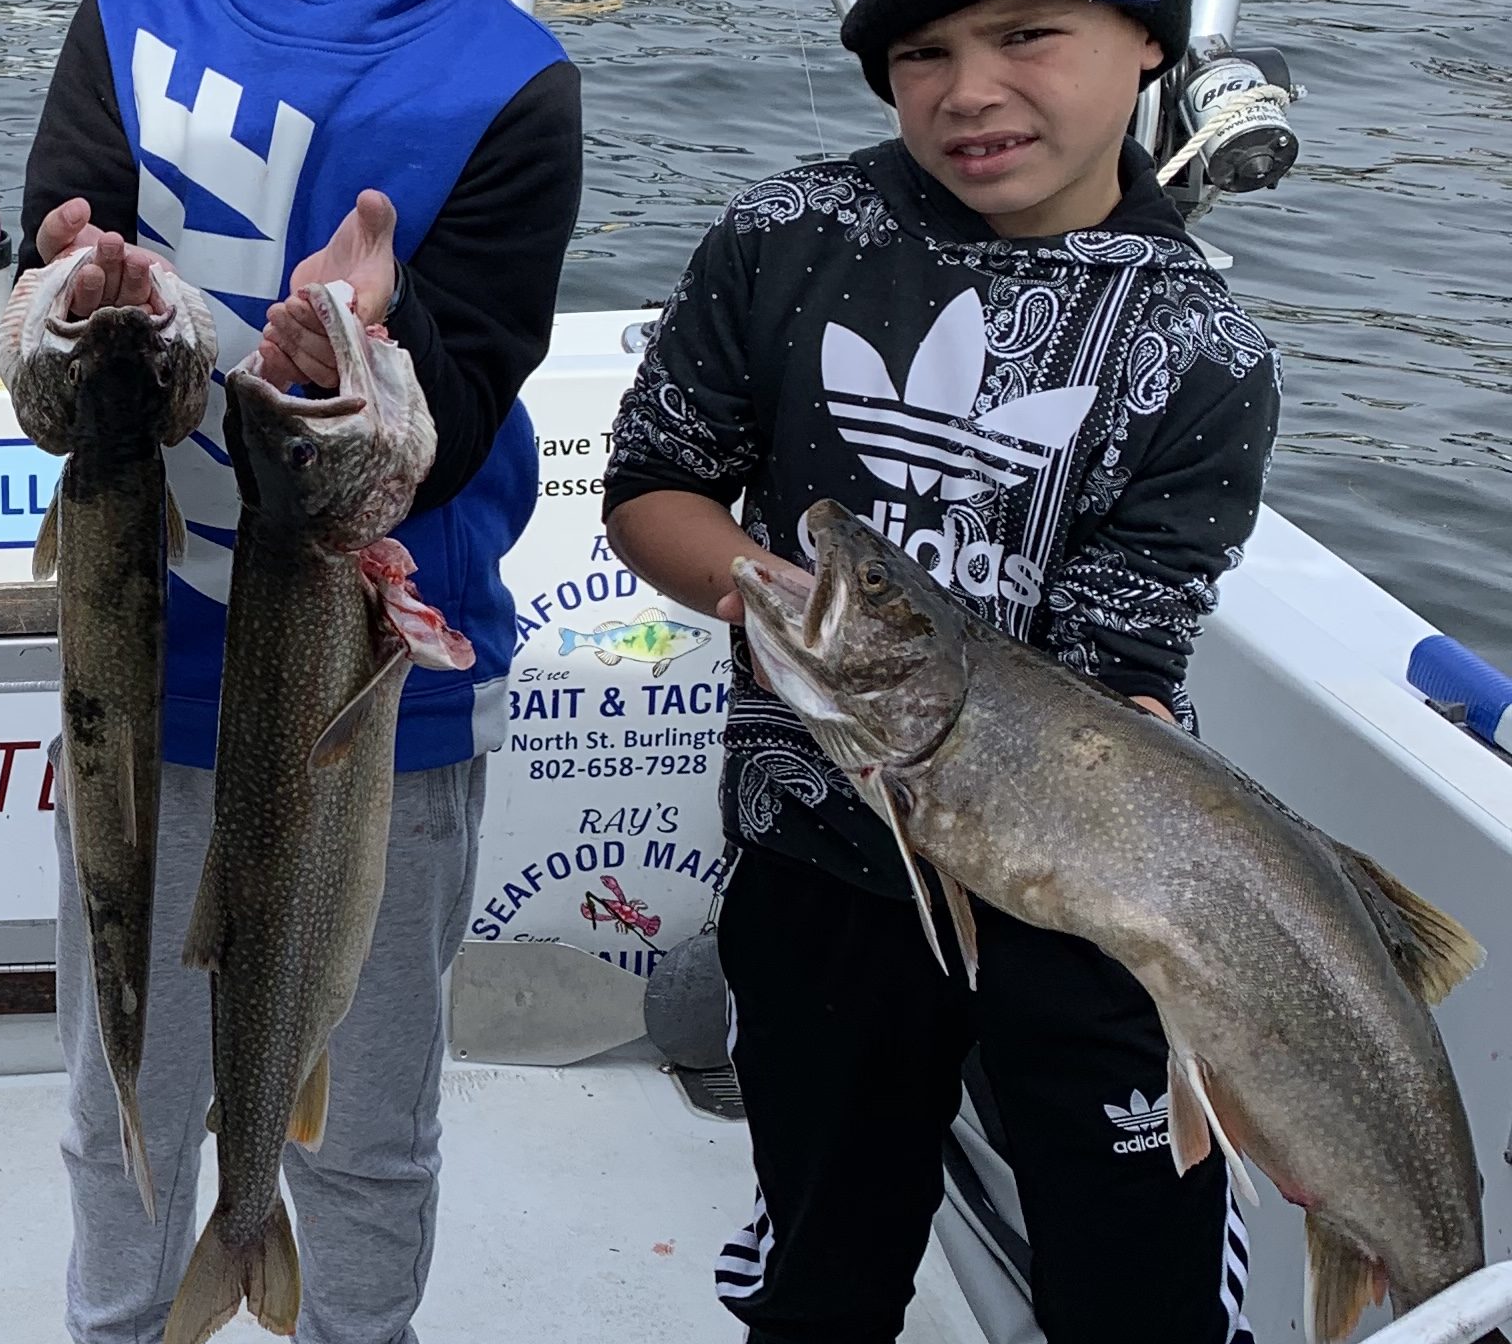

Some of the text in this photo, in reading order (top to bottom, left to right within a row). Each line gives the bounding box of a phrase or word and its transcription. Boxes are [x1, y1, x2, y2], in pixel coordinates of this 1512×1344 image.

[1202, 80, 1243, 109] BIG
[536, 432, 590, 456] ave
[1, 474, 45, 515] LL
[514, 569, 637, 657] AFOOD
[519, 668, 570, 682] Since
[599, 687, 625, 717] &
[641, 682, 729, 716] TACK
[511, 727, 725, 752] North St. Burlingto
[529, 754, 707, 780] 802-658-7928
[579, 802, 679, 836] RAY'S
[471, 840, 727, 941] SEAFOOD MAR
[1113, 1132, 1170, 1153] adida
